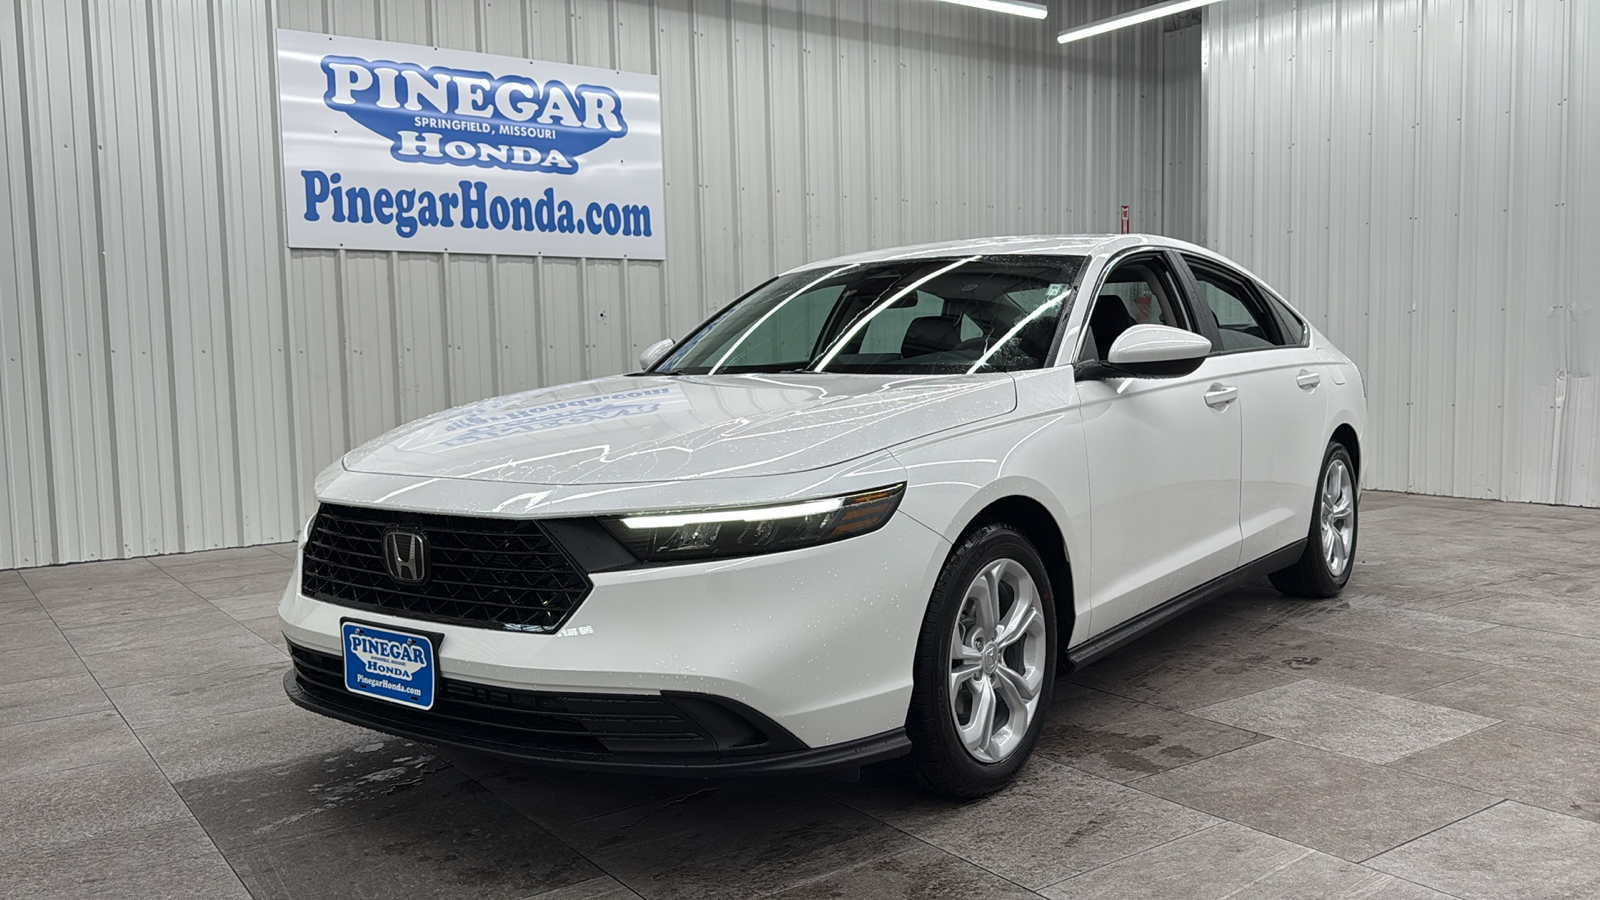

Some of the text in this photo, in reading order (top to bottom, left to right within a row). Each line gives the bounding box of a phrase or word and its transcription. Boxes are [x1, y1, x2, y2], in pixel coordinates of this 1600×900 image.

[328, 62, 623, 132] PINEGAR
[414, 115, 557, 140] SPRINGFIELD, MISSOURI
[300, 169, 652, 238] PinegarHonda.com
[351, 636, 425, 665] PINEGAR
[357, 673, 421, 696] PinegarHonda.com
